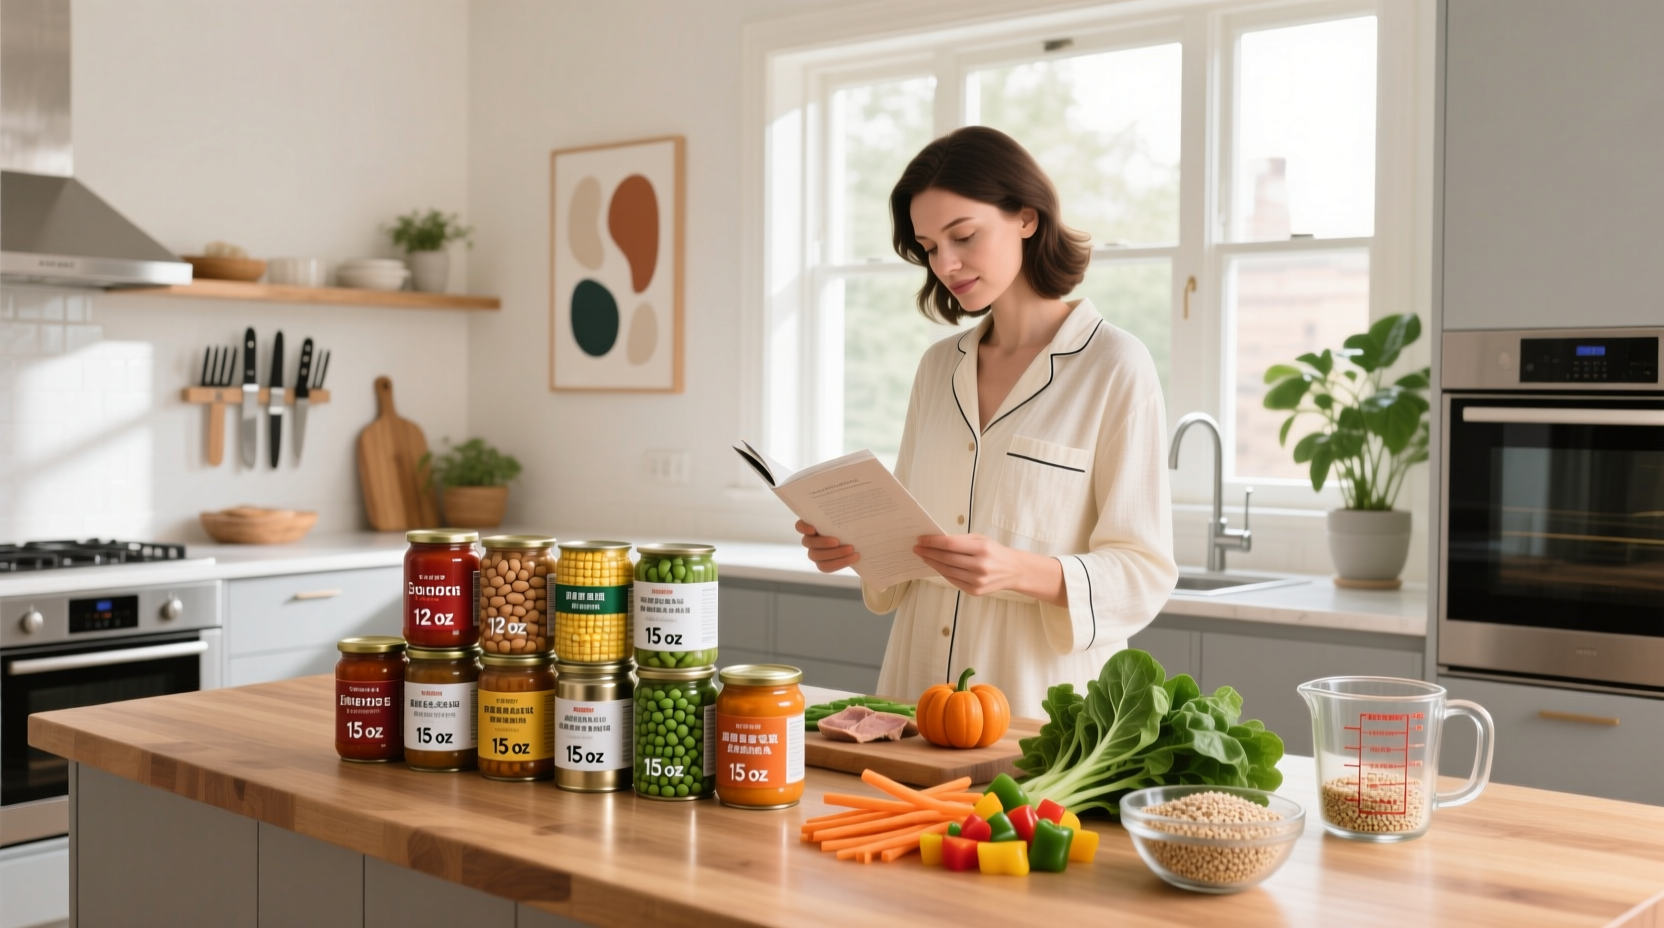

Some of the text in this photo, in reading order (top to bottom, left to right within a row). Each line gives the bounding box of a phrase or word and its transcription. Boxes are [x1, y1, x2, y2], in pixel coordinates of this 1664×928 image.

[414, 608, 454, 626] 12 oz
[488, 617, 527, 636] 12 oz
[645, 627, 682, 645] 15 oz
[347, 721, 383, 739] 15 oz
[417, 727, 453, 744] 15 oz
[492, 738, 530, 755] 15 oz
[566, 745, 604, 763] 15 oz
[644, 758, 684, 777] 15 oz
[730, 763, 768, 782] 15 oz
